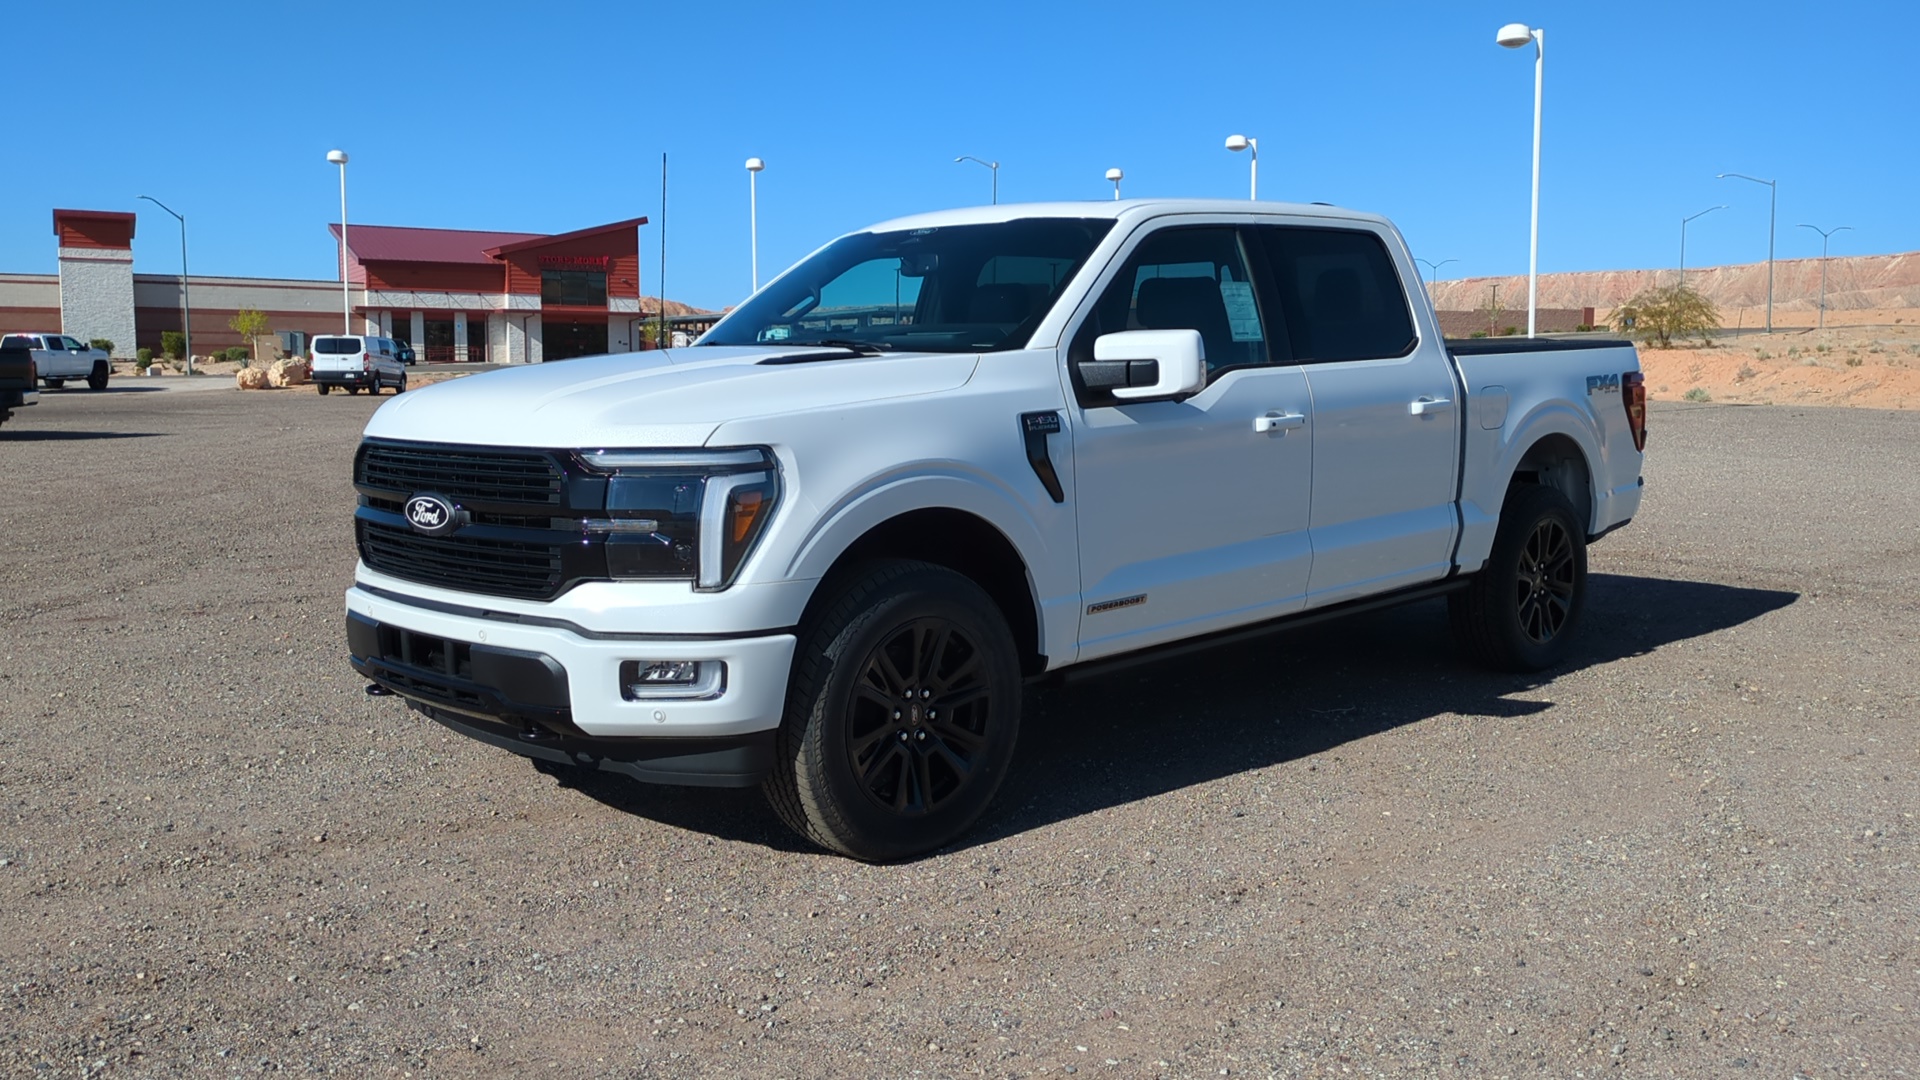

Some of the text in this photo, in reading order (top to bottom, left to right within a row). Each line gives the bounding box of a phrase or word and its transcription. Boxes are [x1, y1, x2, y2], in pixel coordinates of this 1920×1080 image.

[1586, 374, 1619, 396] FX4
[413, 501, 439, 524] Ford
[1091, 596, 1145, 612] POWERBOOST
